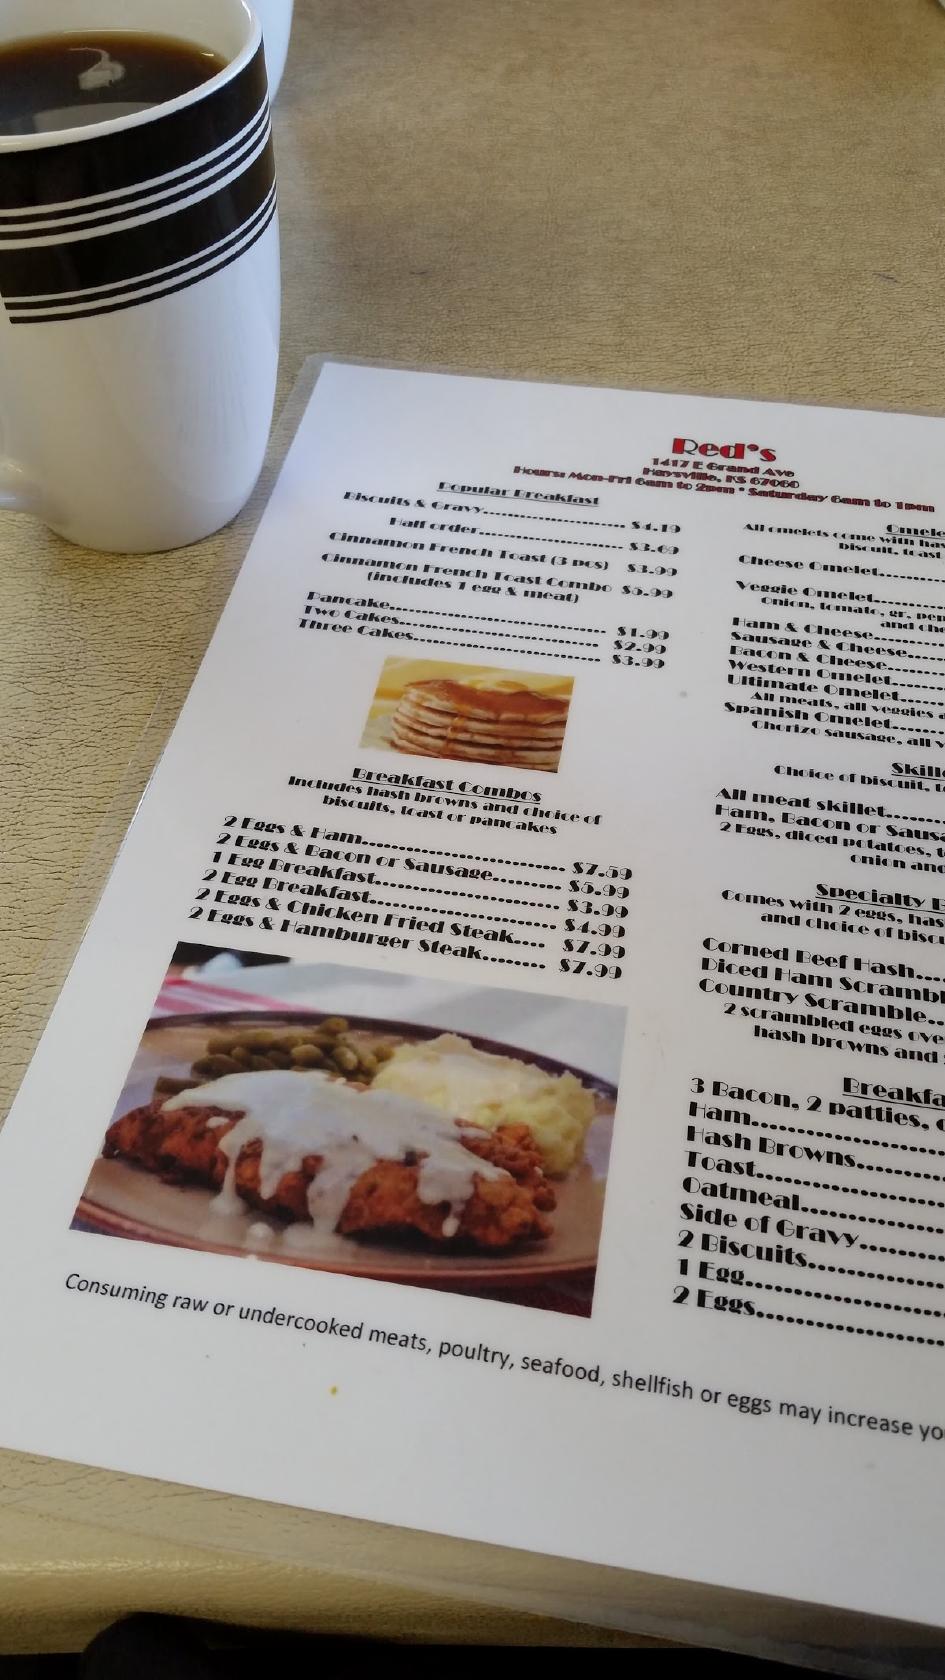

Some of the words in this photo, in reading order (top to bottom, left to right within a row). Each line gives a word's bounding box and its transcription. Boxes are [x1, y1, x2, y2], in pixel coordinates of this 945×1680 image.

[673, 438, 776, 462] Red's
[652, 458, 689, 468] 1417
[693, 461, 703, 469] E
[707, 462, 759, 474] Grand
[763, 468, 795, 477] Ave
[726, 475, 746, 484] KS
[750, 477, 799, 488] 67060
[439, 482, 511, 497] Popular
[514, 490, 599, 505] Breakfast
[568, 472, 631, 484] Mon-Fri
[635, 477, 673, 489] 6am
[677, 481, 692, 490] to
[696, 483, 734, 494] 2pm
[748, 488, 828, 502] Saturday
[831, 495, 870, 506] 6am
[874, 499, 891, 508] to
[897, 502, 934, 512] 1pm
[344, 492, 410, 506] Biscuits
[432, 502, 483, 513] Gravy
[632, 521, 680, 533] $4.19
[329, 532, 424, 550] Cinnamon
[430, 543, 492, 557] French
[500, 550, 546, 562] Toast
[628, 564, 677, 576] $3.99
[630, 542, 679, 554] $3.69
[739, 555, 804, 569] Cheese
[809, 562, 878, 576] Omelet
[736, 581, 798, 595] Veggie
[803, 588, 873, 601] Omelet
[304, 605, 340, 617] Two
[345, 610, 399, 624] Cakes
[613, 640, 666, 655] $2.99
[307, 592, 390, 609] Pancake
[617, 626, 670, 640] $1.99
[732, 617, 779, 630] Ham
[804, 624, 873, 639] Cheese
[299, 618, 352, 633] Three
[358, 626, 413, 640] Cakes
[611, 654, 665, 669] $3.99
[730, 646, 791, 660] Bacon
[817, 654, 887, 670] Cheese
[731, 632, 812, 648] Sausage
[836, 642, 907, 657] Cheese
[728, 674, 818, 692] Ultimate
[824, 684, 899, 700] Omelet
[729, 660, 810, 676] Western
[817, 669, 892, 685] Omelet
[724, 702, 808, 720] Spanish
[815, 712, 892, 728] Omelet
[352, 768, 454, 790] Breakfast
[459, 782, 541, 801] Combos
[774, 765, 834, 780] Choice
[839, 774, 857, 782] of
[861, 775, 930, 792] biscuit,
[288, 776, 362, 795] Includes
[367, 787, 409, 800] hash
[415, 791, 478, 810] browns
[483, 803, 519, 814] and
[523, 807, 579, 822] choice
[584, 814, 602, 825] of
[716, 788, 746, 800] All
[753, 793, 811, 808] meat
[817, 800, 887, 817] skillet
[715, 805, 775, 823] Ham,
[782, 812, 850, 830] Bacon
[223, 815, 237, 827] 2
[241, 817, 286, 833] Eggs
[311, 827, 362, 844] Ham
[572, 862, 632, 880] $7.59
[217, 832, 231, 844] 2
[235, 835, 280, 851] Eggs
[305, 845, 371, 864] Bacon
[376, 856, 400, 867] or
[404, 858, 492, 880] Sausage
[568, 880, 629, 898] $5.99
[212, 851, 222, 863] 1
[228, 853, 265, 869] Egg
[269, 858, 376, 884] Breakfast
[568, 900, 628, 918] $3.99
[816, 884, 926, 907] Specialty
[201, 869, 217, 881] 2
[221, 871, 258, 887] Egg
[263, 877, 371, 903] Breakfast
[564, 919, 626, 938] $4.99
[722, 890, 784, 907] Comes
[790, 899, 833, 913] with
[839, 905, 850, 915] 2
[855, 908, 902, 924] eggs,
[195, 888, 210, 900] 2
[214, 890, 260, 907] Eggs
[287, 900, 379, 924] Chicken
[384, 913, 444, 933] Fried
[450, 923, 514, 943] Steak
[563, 939, 626, 959] $7.99
[761, 913, 800, 926] and
[806, 918, 869, 934] choice
[874, 928, 893, 938] of
[188, 907, 203, 919] 2
[207, 909, 254, 926] Eggs
[280, 920, 414, 949] Hamburger
[418, 939, 482, 960] Steak
[559, 959, 622, 979] $7.99
[703, 938, 788, 961] Corned
[796, 950, 849, 968] Beef
[854, 958, 914, 978] Hash
[702, 958, 767, 978] Diced
[775, 967, 832, 988] Ham
[699, 979, 799, 1004] Country
[805, 993, 926, 1023] Scramble
[724, 1003, 736, 1015] 2
[741, 1007, 854, 1032] scrambled
[859, 1024, 902, 1040] eggs
[754, 1025, 805, 1044] hash
[812, 1034, 889, 1056] browns
[895, 1047, 938, 1063] and
[689, 1102, 750, 1125] Ham
[691, 1078, 704, 1093] 3
[713, 1081, 799, 1111] Bacon,
[807, 1096, 821, 1112] 2
[829, 1101, 929, 1131] patties,
[687, 1126, 751, 1150] Hash
[759, 1137, 855, 1167] Browns
[684, 1151, 756, 1176] Toast
[683, 1177, 800, 1211] Oatmeal
[680, 1203, 737, 1227] Side
[745, 1216, 771, 1233] of
[776, 1220, 859, 1247] Gravy
[678, 1230, 694, 1248] 2
[702, 1233, 807, 1267] Biscuits
[678, 1259, 688, 1275] 1
[699, 1261, 745, 1285] Egg
[673, 1286, 690, 1304] 2
[697, 1289, 755, 1315] Eggs
[65, 1274, 168, 1309] Consuming
[172, 1294, 208, 1312] raw
[213, 1302, 235, 1317] or
[239, 1306, 363, 1340] undercooked
[369, 1329, 432, 1354] meats,
[438, 1342, 514, 1370] poultry,
[521, 1356, 605, 1386] seafood,
[612, 1371, 693, 1400] shellfish
[701, 1388, 721, 1403] or
[728, 1392, 772, 1415] eggs
[779, 1401, 821, 1425] may
[828, 1407, 913, 1435] increase
